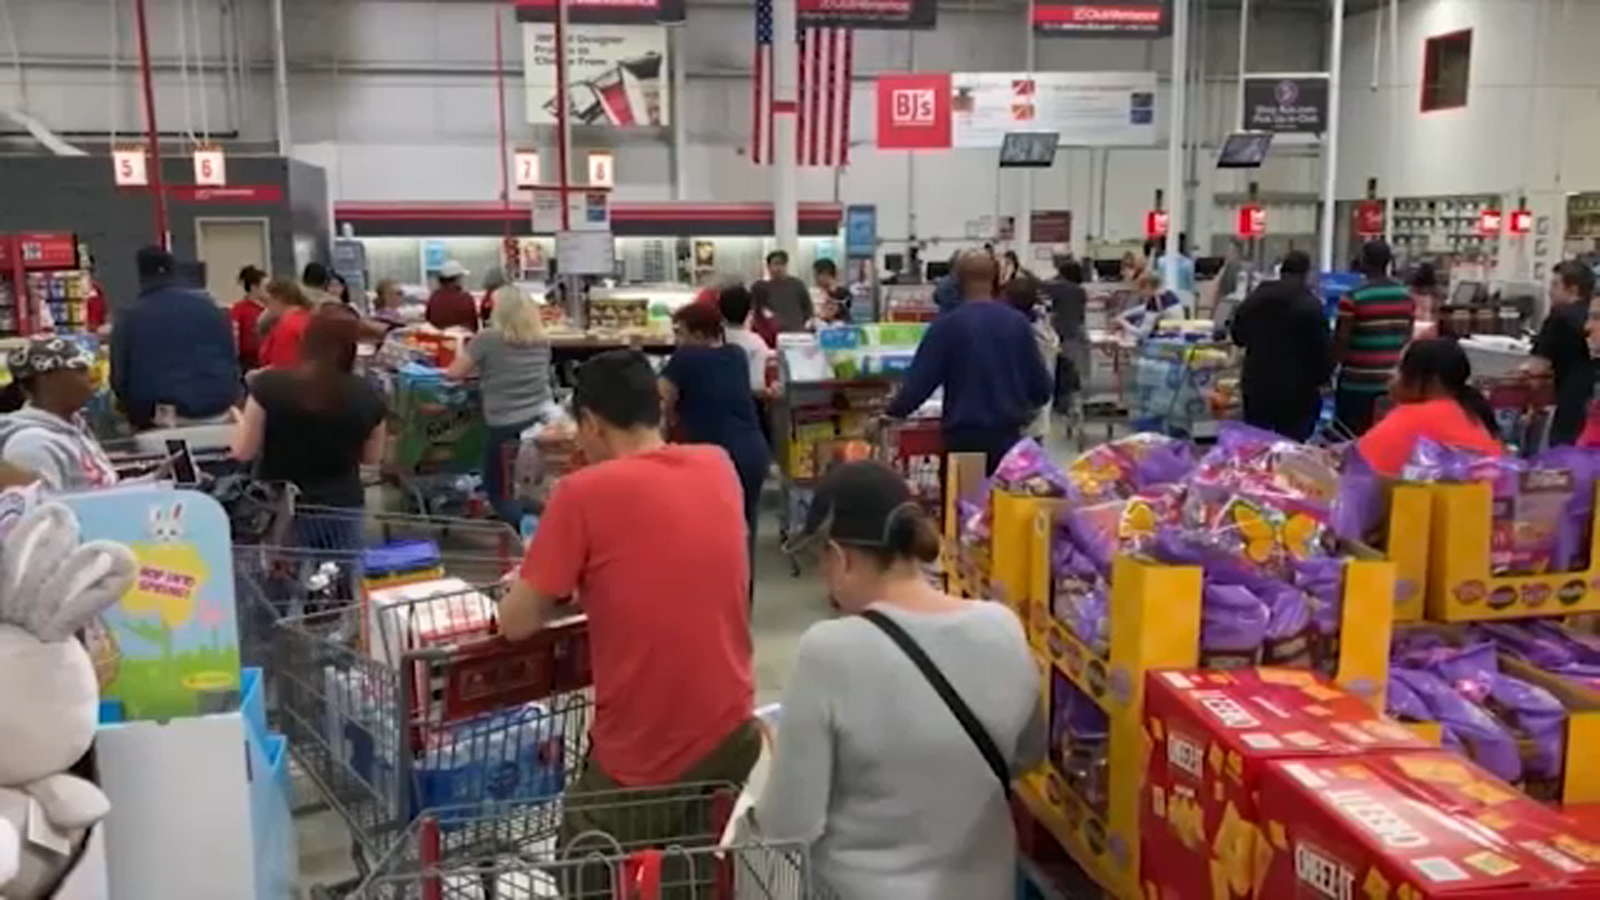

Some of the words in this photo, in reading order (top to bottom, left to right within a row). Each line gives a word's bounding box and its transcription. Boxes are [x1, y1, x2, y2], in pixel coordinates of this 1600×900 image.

[897, 93, 931, 121] BJ's
[121, 159, 132, 178] 5
[201, 159, 212, 178] 6
[523, 160, 531, 180] 7
